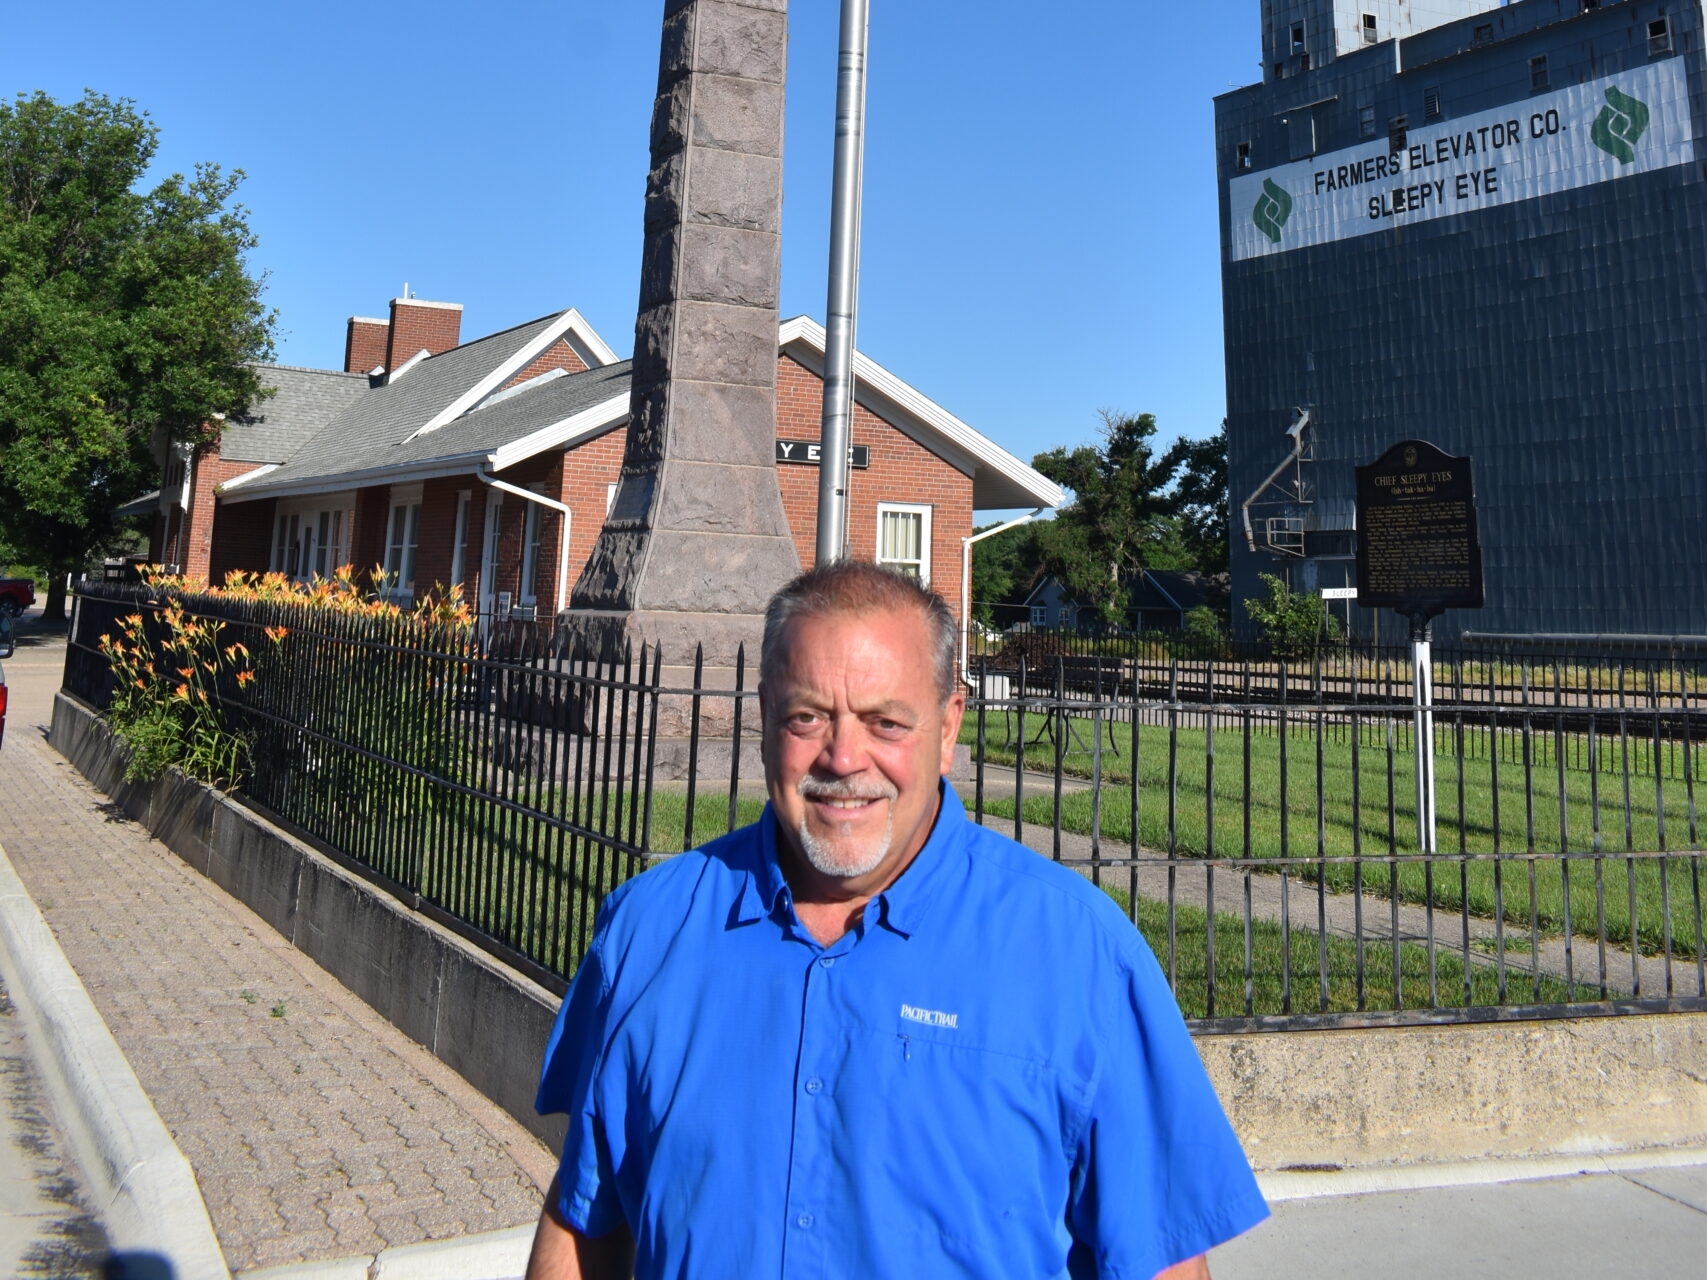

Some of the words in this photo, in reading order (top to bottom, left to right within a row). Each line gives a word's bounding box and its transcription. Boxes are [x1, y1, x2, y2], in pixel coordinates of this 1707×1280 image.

[1314, 152, 1400, 195] FARMERS
[1409, 119, 1520, 170] ELEVATOR
[1530, 109, 1566, 139] CO.
[1368, 179, 1445, 220] SLEEPY
[1456, 167, 1498, 199] EYE
[1374, 476, 1397, 487] CHIEF
[1400, 473, 1427, 484] SLEEPY
[1432, 471, 1452, 482] EYES
[901, 1004, 934, 1023] PACIFIC
